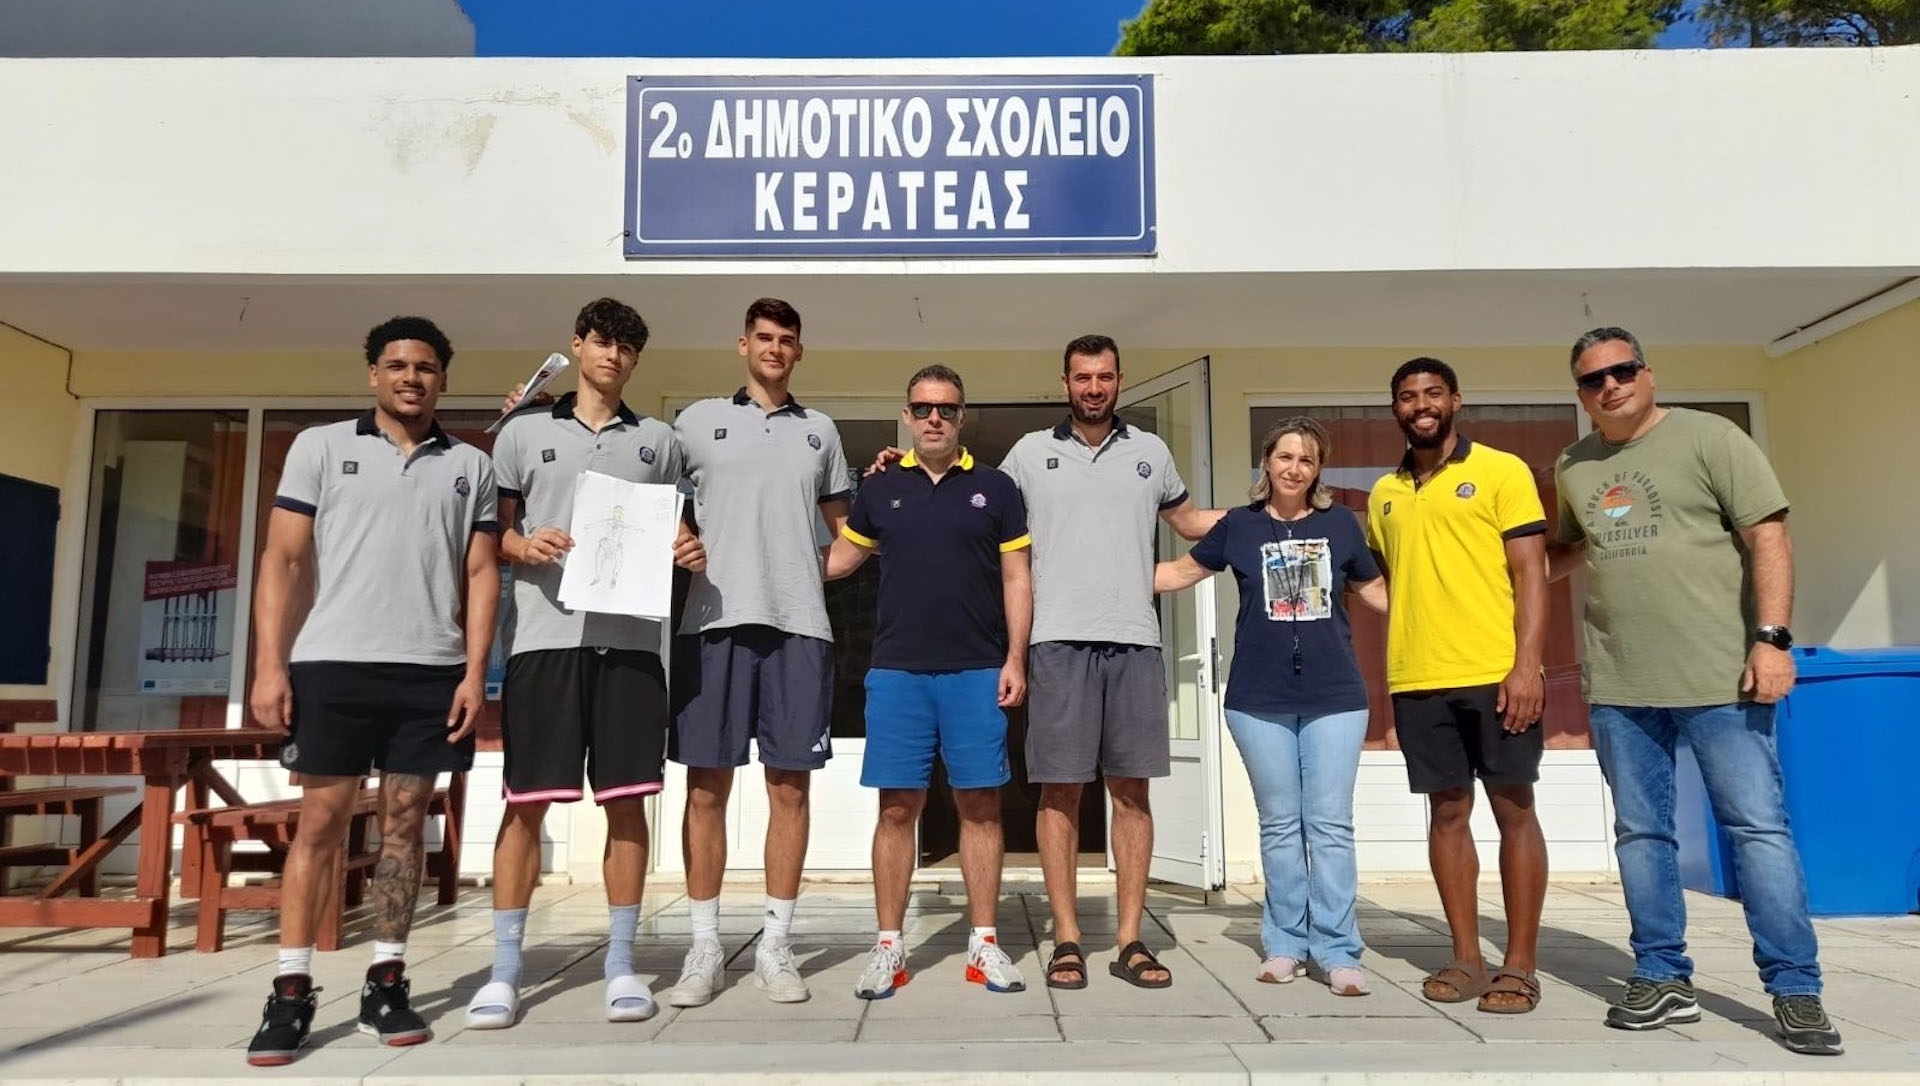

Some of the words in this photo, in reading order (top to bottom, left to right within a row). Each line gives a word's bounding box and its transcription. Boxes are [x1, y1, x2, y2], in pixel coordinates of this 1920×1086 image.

[704, 97, 932, 158] ΔΗΜΟΤΙΚΟ
[946, 97, 1130, 157] ΣΧΟΛΕΙΟ
[755, 170, 1030, 231] ΚΕΡΑΤΕΑΣ
[1586, 481, 1611, 515] TOUCH
[1614, 471, 1628, 483] OF
[1632, 471, 1662, 519] PARADISE
[1597, 525, 1658, 544] UIKSILVER
[1600, 545, 1647, 561] CALIFORNIA
